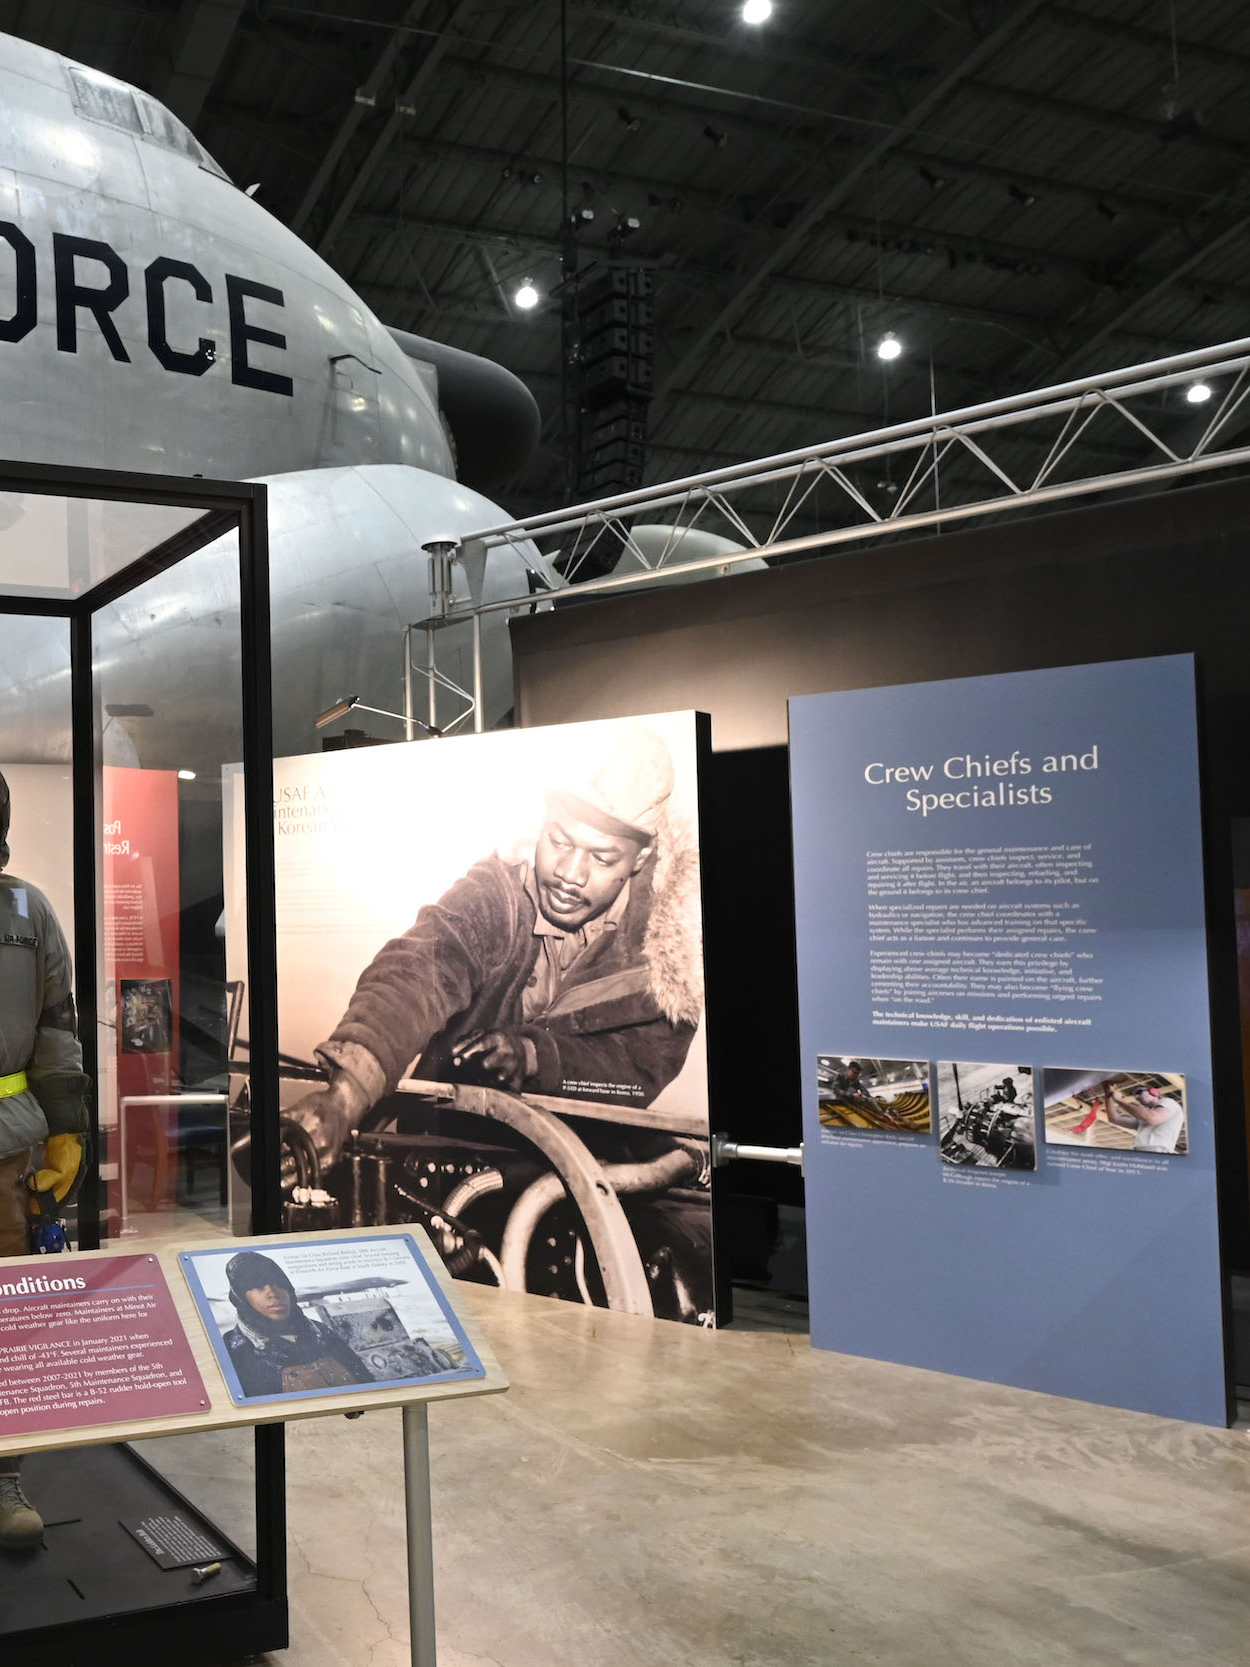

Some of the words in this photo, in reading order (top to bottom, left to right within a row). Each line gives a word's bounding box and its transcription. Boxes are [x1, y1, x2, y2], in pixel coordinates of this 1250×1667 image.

[863, 762, 933, 785] Crew
[943, 751, 1032, 780] Chiefs
[1042, 745, 1099, 772] and
[905, 782, 1053, 817] Specialists
[278, 820, 327, 835] Korean
[15, 935, 38, 947] FORCE
[885, 1010, 914, 1018] technical
[1034, 1016, 1063, 1024] enlisted
[950, 1020, 966, 1030] daily
[968, 1021, 986, 1030] flight
[2, 1307, 21, 1315] drop.
[23, 1303, 49, 1312] Aircraft
[50, 1300, 90, 1310] maintainers
[121, 1294, 137, 1303] with
[138, 1293, 153, 1301] their
[31, 1312, 53, 1320] below
[74, 1306, 115, 1316] Maintainers
[116, 1304, 123, 1312] at
[124, 1302, 145, 1311] Minot
[146, 1301, 156, 1309] Air
[0, 1323, 16, 1332] cold
[18, 1321, 46, 1330] weather
[48, 1320, 63, 1329] gear
[65, 1317, 78, 1325] like
[79, 1316, 91, 1324] the
[92, 1314, 120, 1322] uniform
[120, 1312, 136, 1320] here
[138, 1310, 148, 1318] for
[28, 1340, 71, 1351] VIGILANCE
[81, 1338, 108, 1346] January
[110, 1334, 127, 1343] 2021
[129, 1333, 148, 1341] when
